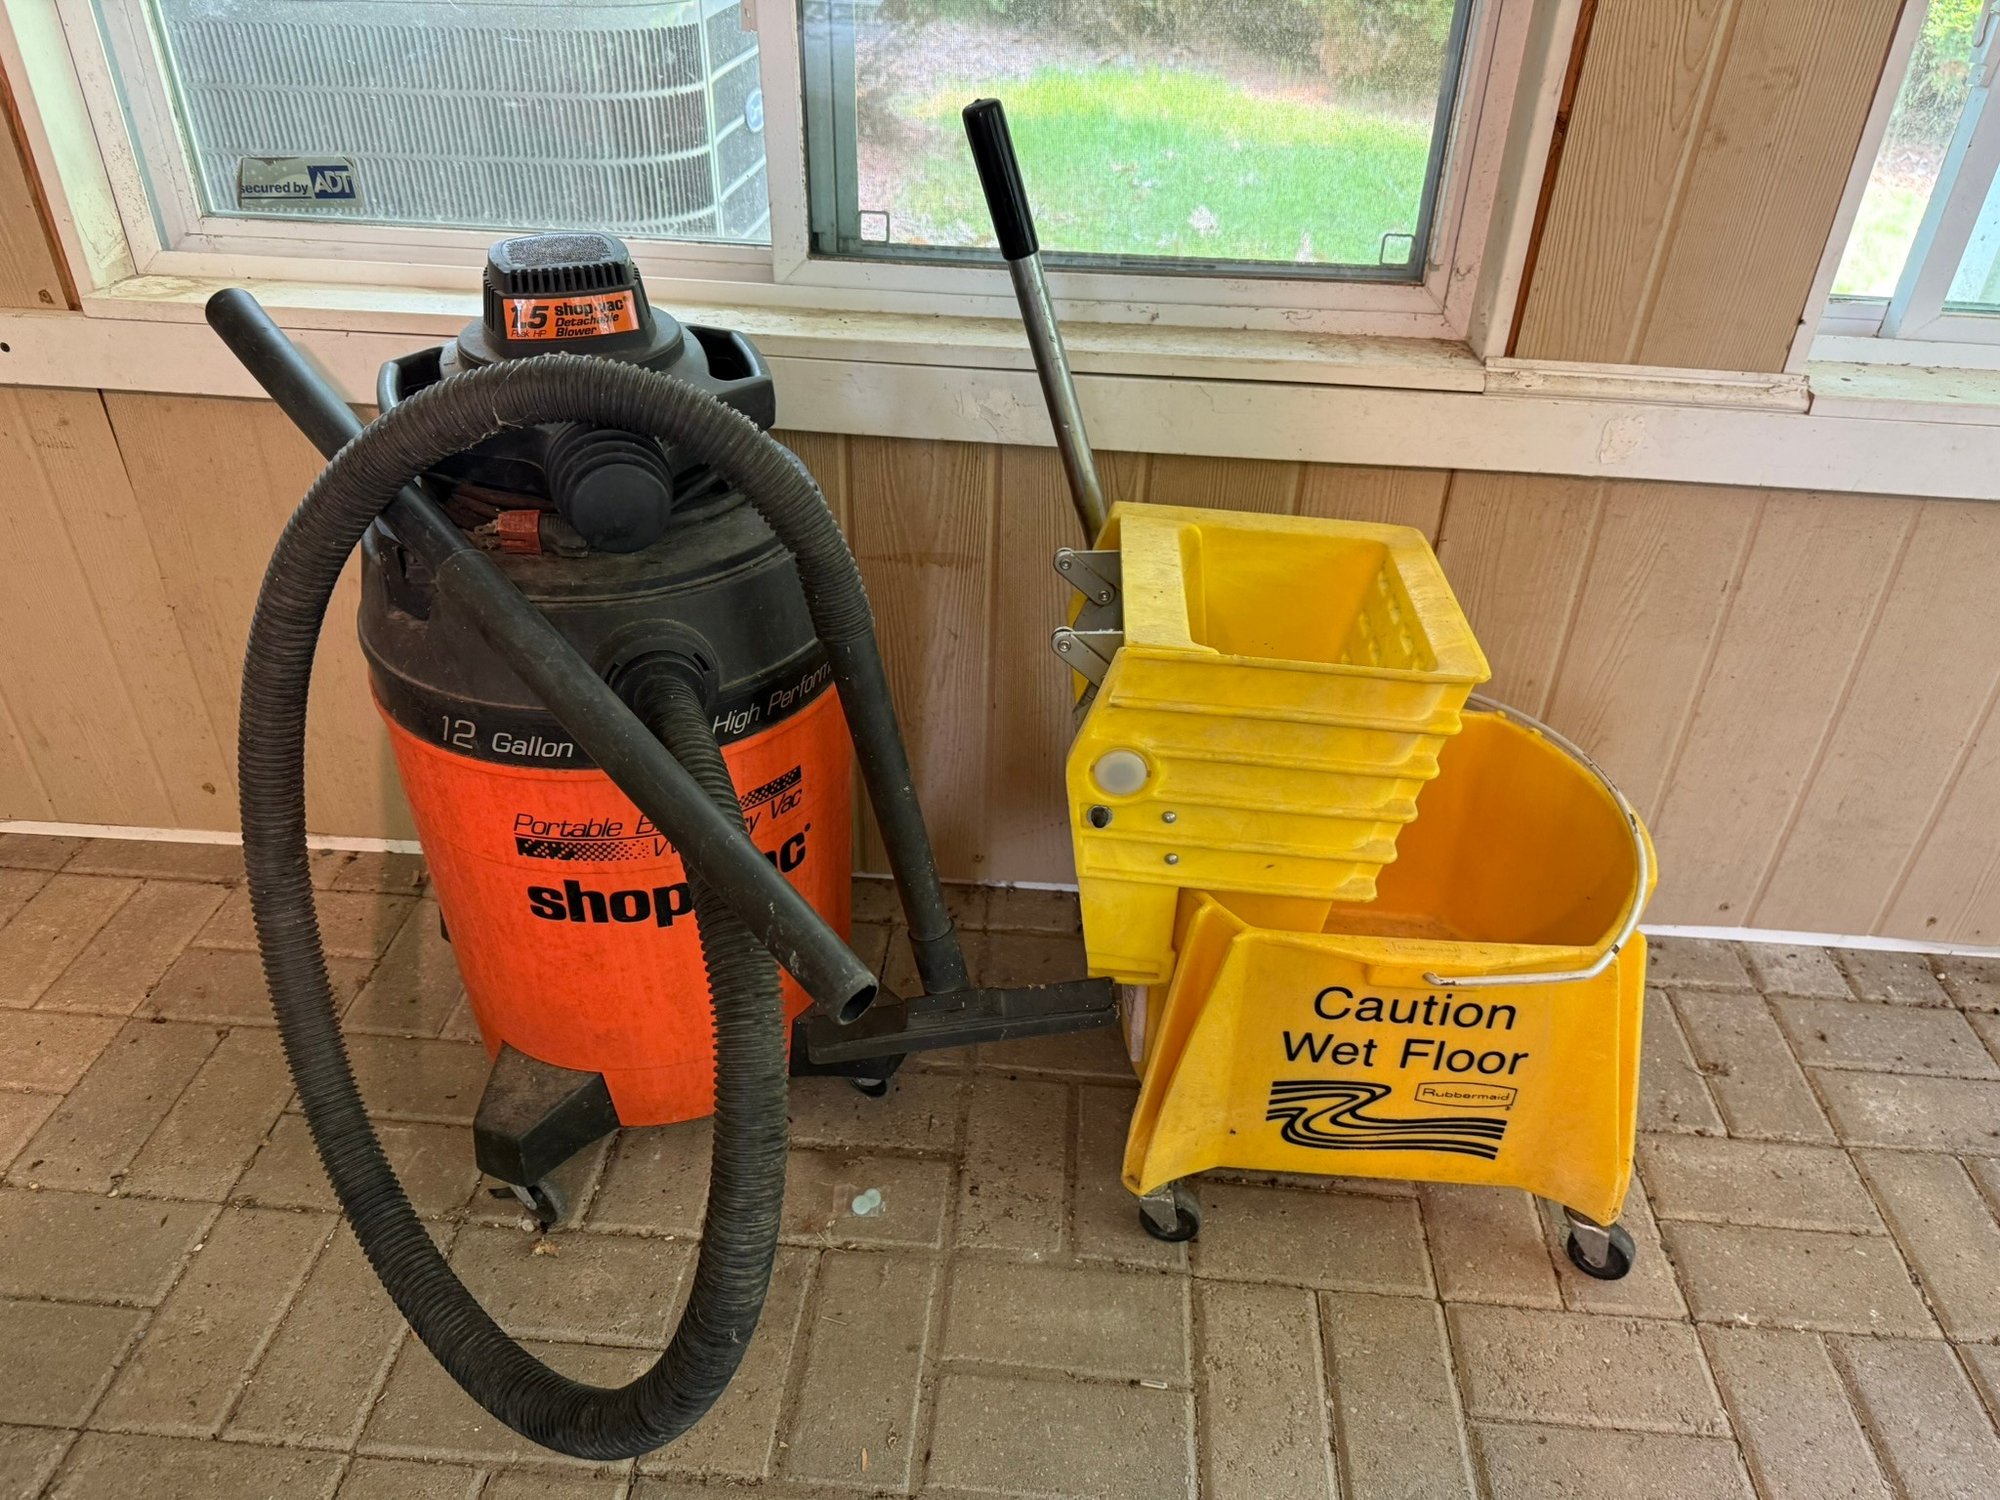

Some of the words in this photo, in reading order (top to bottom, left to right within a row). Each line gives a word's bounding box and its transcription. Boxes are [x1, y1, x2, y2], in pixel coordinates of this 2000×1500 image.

[240, 182, 291, 194] secured
[294, 182, 308, 195] by
[314, 170, 352, 194] ADT
[556, 326, 597, 337] Blower
[712, 703, 760, 734] High
[442, 716, 476, 749] 12
[492, 732, 573, 758] Gallon
[769, 789, 802, 819] Vac
[514, 813, 623, 838] Portable
[1314, 986, 1516, 1030] Caution
[1283, 1031, 1377, 1067] Wet
[1400, 1038, 1529, 1075] Floor
[1423, 1088, 1510, 1101] Rubbermaid
